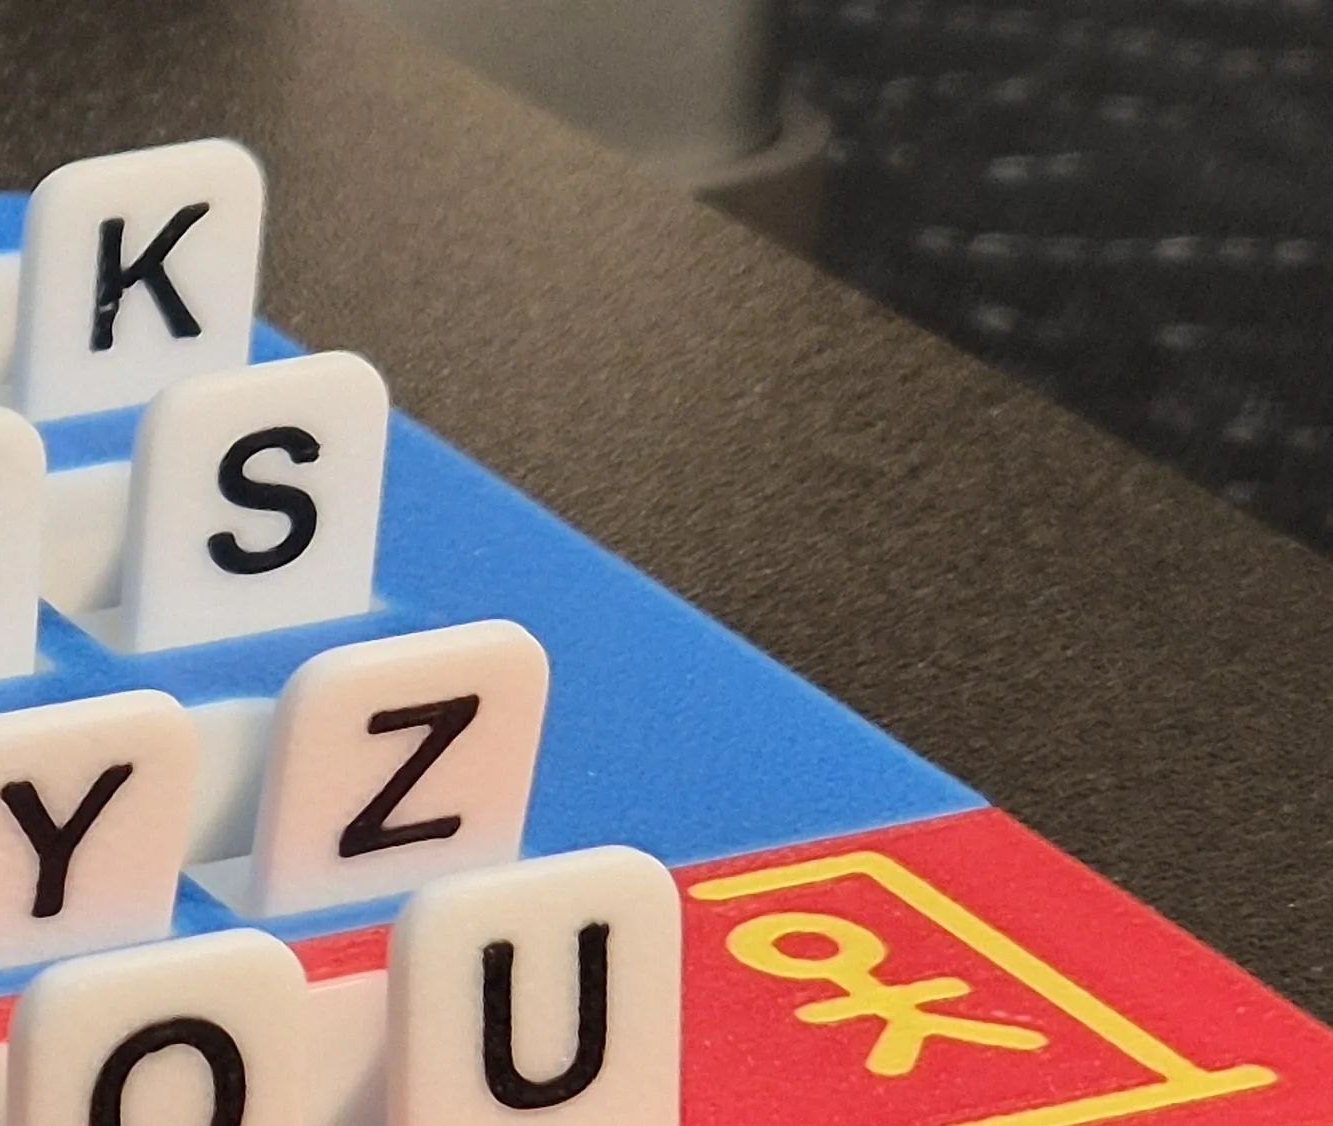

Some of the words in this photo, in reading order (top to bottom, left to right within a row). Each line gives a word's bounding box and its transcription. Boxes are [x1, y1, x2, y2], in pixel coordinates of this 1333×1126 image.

[90, 201, 211, 352] K
[206, 425, 322, 576] S
[337, 693, 481, 860] Z
[480, 921, 611, 1111] U
